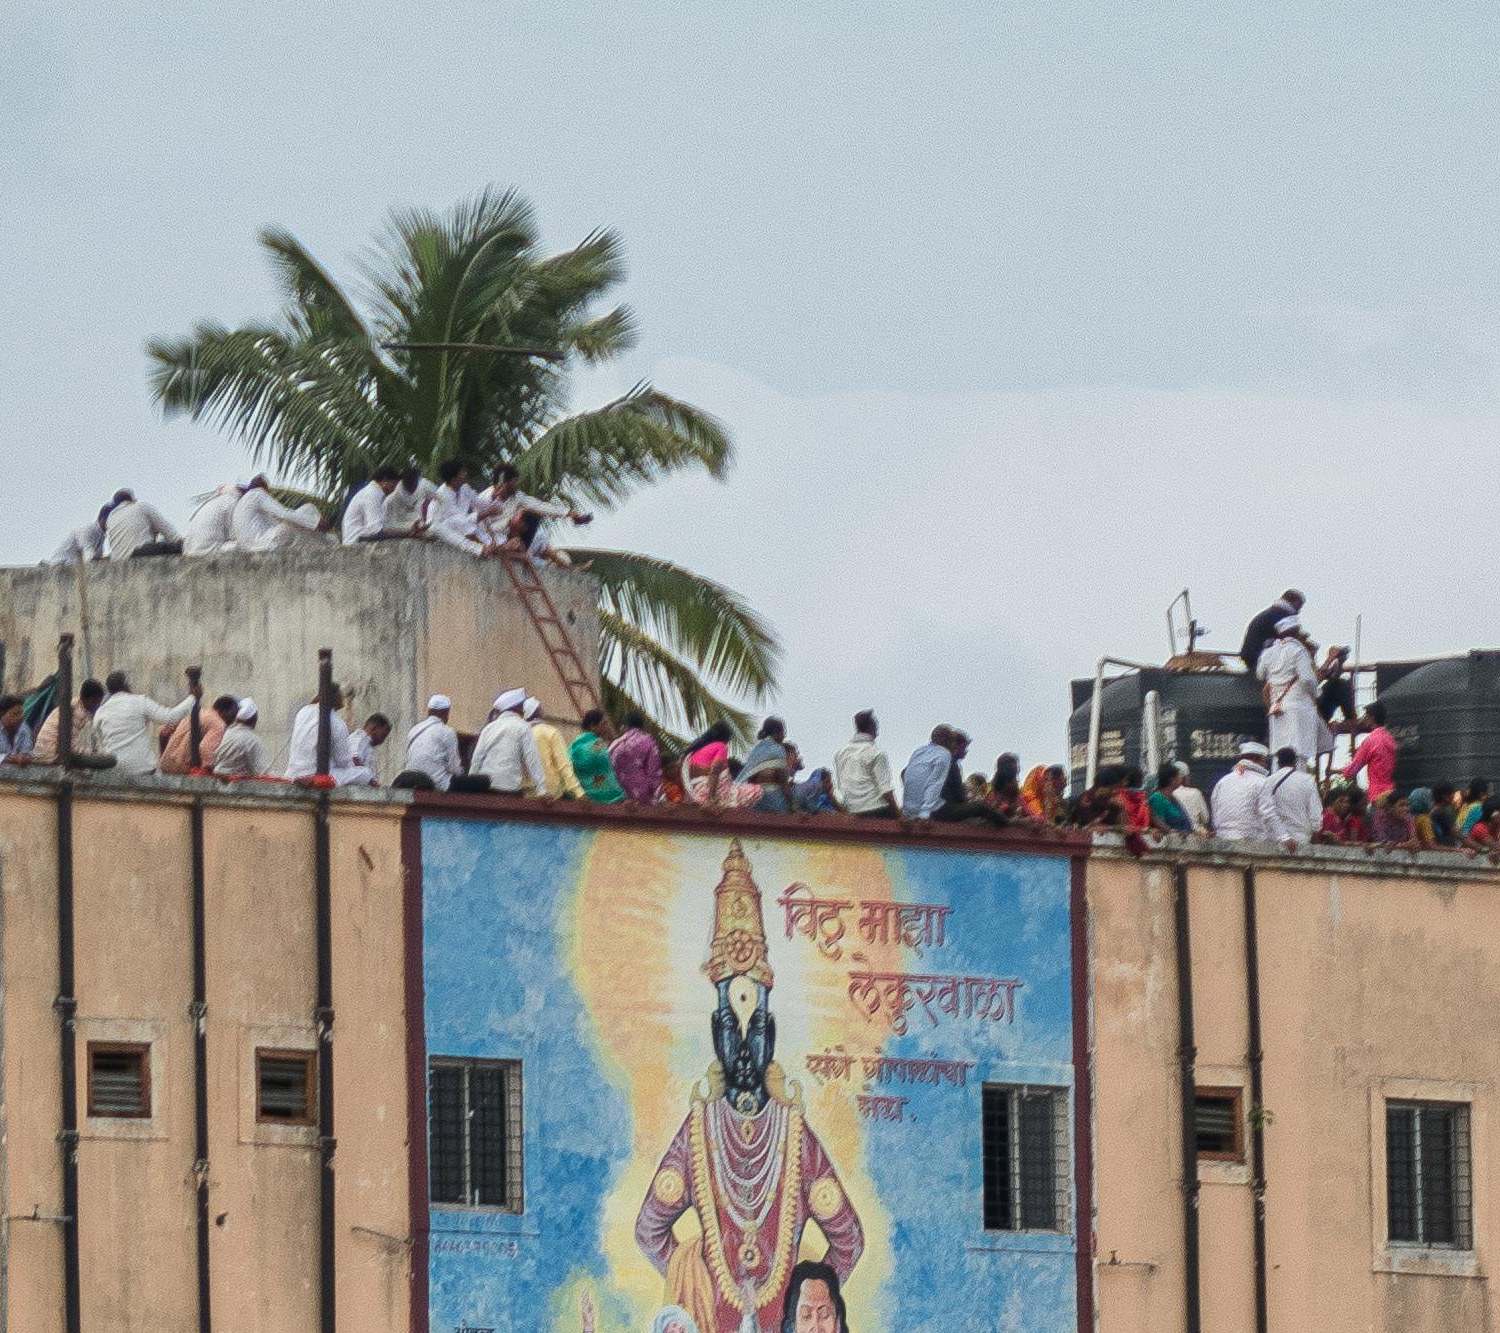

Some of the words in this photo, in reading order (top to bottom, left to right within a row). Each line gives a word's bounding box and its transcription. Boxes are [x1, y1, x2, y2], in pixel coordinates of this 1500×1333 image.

[778, 881, 853, 961] विठु
[859, 899, 955, 958] माझा
[847, 952, 1023, 1037] लेकुरवाळा
